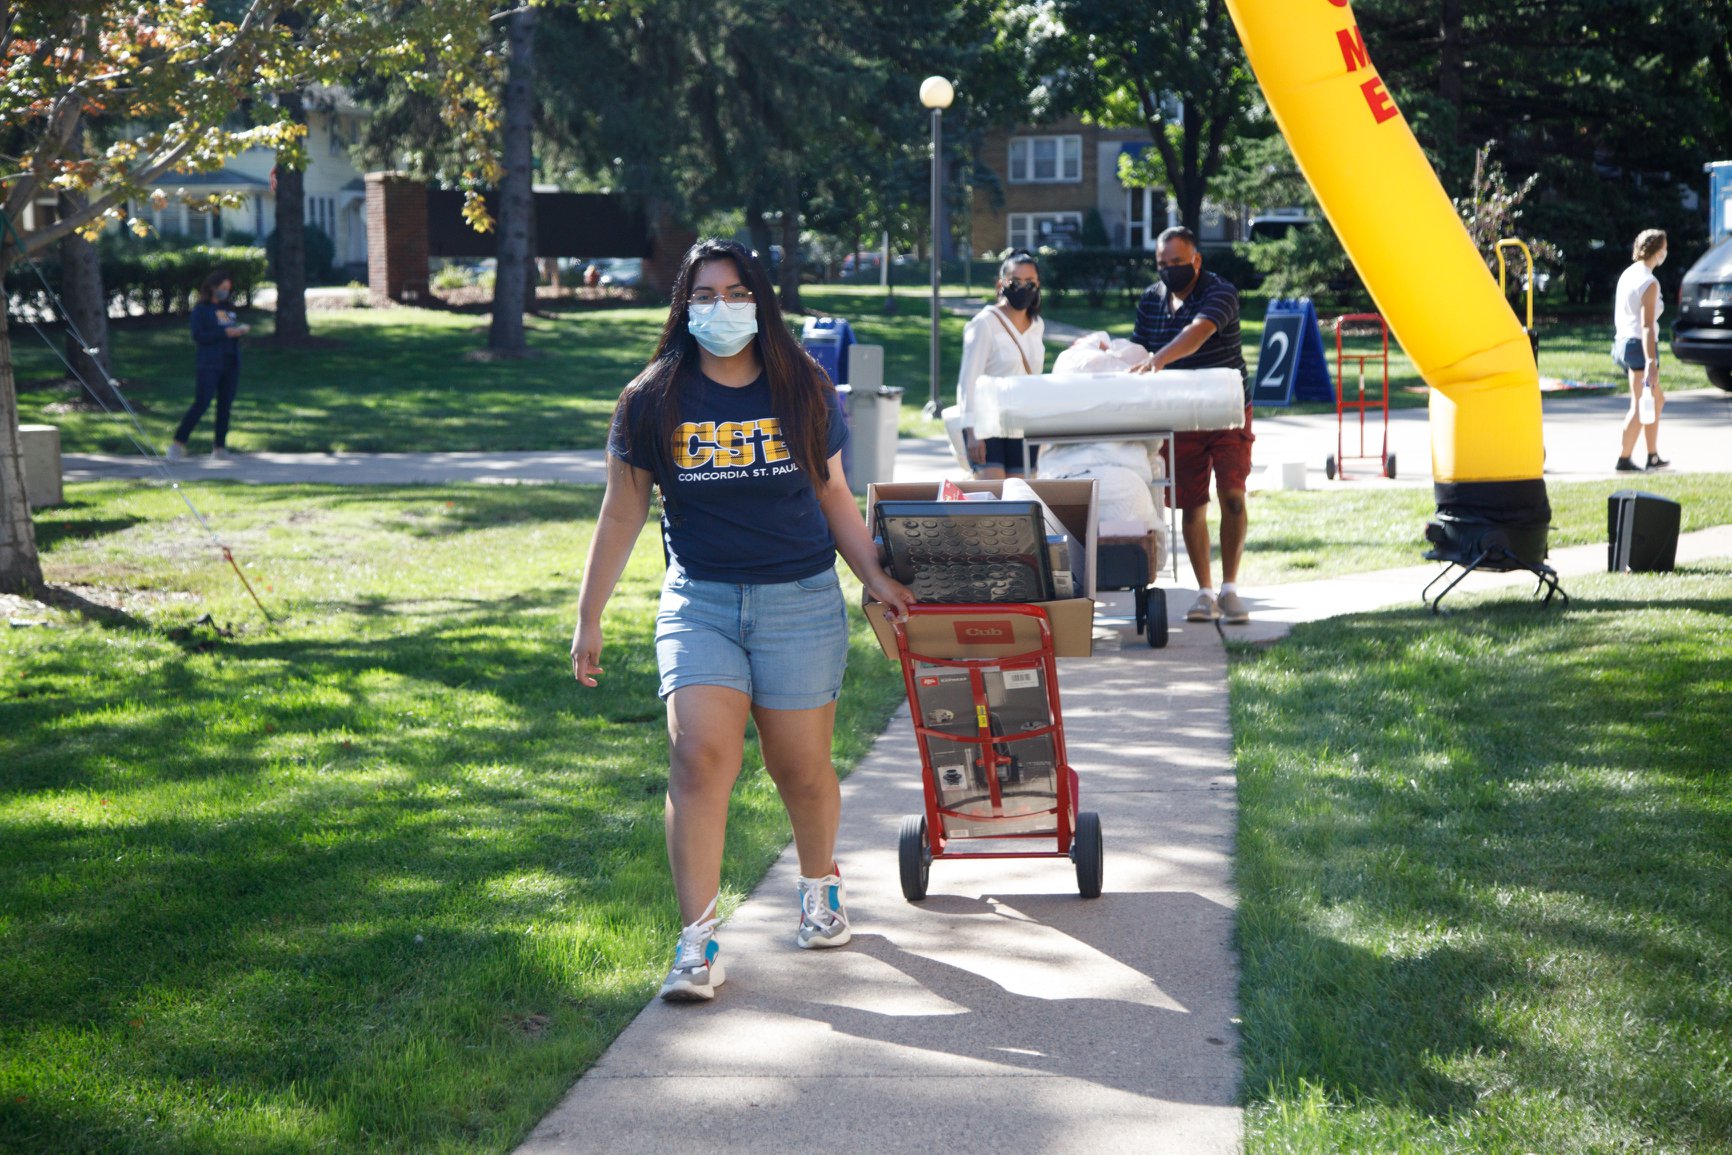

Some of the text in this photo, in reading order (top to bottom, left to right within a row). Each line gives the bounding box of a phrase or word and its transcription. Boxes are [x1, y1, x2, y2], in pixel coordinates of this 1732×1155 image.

[1327, 0, 1399, 125] ME
[1260, 331, 1289, 386] 2
[678, 463, 799, 482] CONCORDIA ST. PAUL
[966, 628, 1002, 636] Cub
